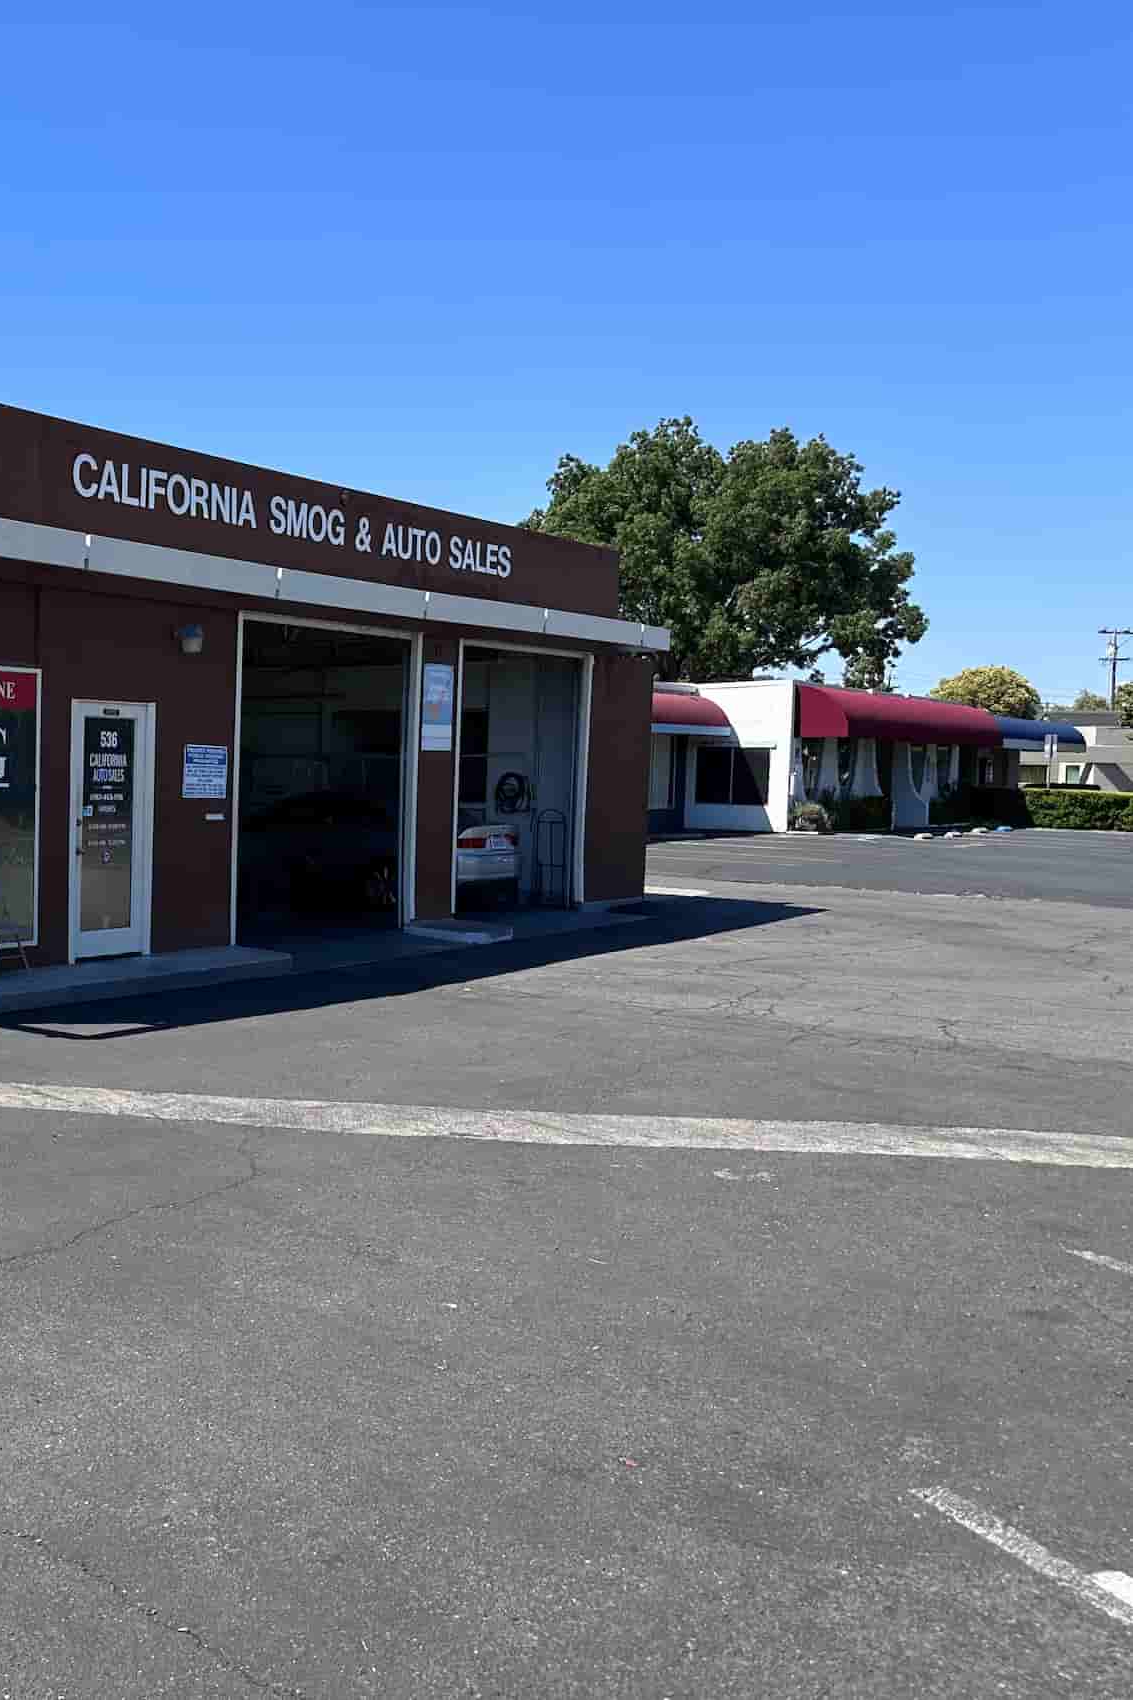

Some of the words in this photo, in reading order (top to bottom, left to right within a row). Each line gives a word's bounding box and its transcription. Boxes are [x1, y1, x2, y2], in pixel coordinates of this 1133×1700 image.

[72, 453, 257, 530] CALIFORNIA
[269, 495, 345, 547] SMOG
[354, 516, 372, 554] &
[382, 522, 442, 567] AUTO
[449, 536, 512, 579] SALES
[100, 731, 118, 748] 536
